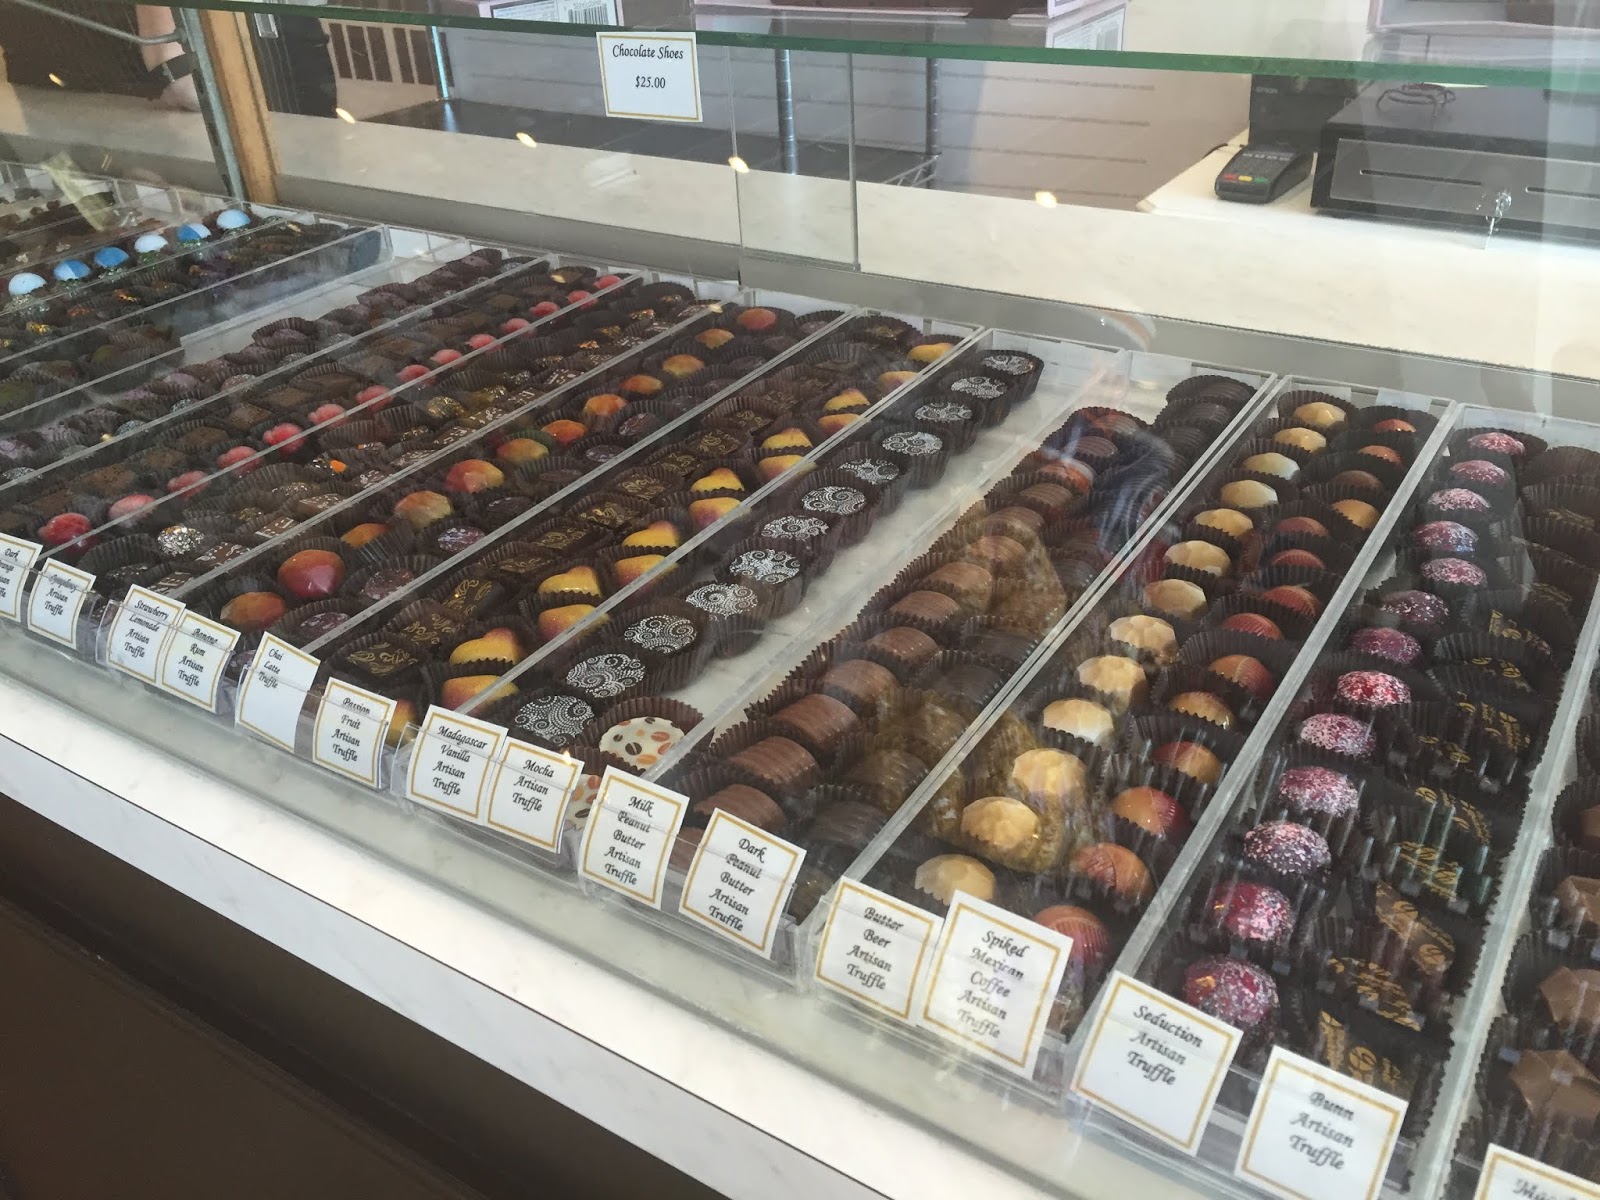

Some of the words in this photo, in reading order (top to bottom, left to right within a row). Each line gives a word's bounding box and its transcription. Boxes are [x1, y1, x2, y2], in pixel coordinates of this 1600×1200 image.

[612, 44, 656, 59] Chocolate
[657, 45, 684, 60] Shoes
[635, 76, 666, 89] $25.00
[4, 548, 20, 561] Dark
[46, 588, 68, 603] Artisan
[45, 601, 64, 615] Truffle
[135, 600, 169, 621] Strawberry
[129, 613, 160, 632] Lemonade
[125, 628, 150, 644] Artisan
[124, 642, 145, 658] Truffle
[190, 643, 206, 656] Rum
[268, 648, 284, 661] Chai
[179, 656, 204, 672] Artisan
[264, 661, 281, 674] Latte
[178, 669, 200, 687] Truffle
[258, 671, 278, 689] Truffle
[341, 714, 361, 730] Fruit
[331, 729, 360, 746] Artisan
[438, 725, 488, 749] Madagascar
[333, 745, 358, 762] Truffle
[440, 744, 470, 763] Vanilla
[433, 761, 465, 779] Artisan
[523, 759, 555, 778] Mocha
[432, 777, 461, 795] Truffle
[513, 775, 549, 795] Artisan
[512, 792, 543, 812] Truffle
[628, 796, 655, 818] Milk
[617, 811, 651, 833] Peanut
[613, 829, 646, 850] Butter
[604, 846, 641, 869] Artisan
[738, 838, 766, 864] Dark
[604, 863, 638, 885] Truffle
[725, 853, 763, 879] Peanut
[720, 871, 755, 896] Butter
[709, 888, 749, 916] Artisan
[708, 905, 744, 931] Truffle
[864, 907, 904, 931] Butter
[862, 928, 892, 948] Beer
[981, 930, 1030, 958] Spiked
[846, 945, 892, 972] Artisan
[969, 947, 1024, 980] Mexican
[846, 964, 887, 990] Truffle
[970, 970, 1011, 998] Coffee
[957, 990, 1007, 1021] Artisan
[957, 1008, 1001, 1039] Truffle
[1133, 1005, 1204, 1049] Seduction
[1129, 1031, 1187, 1066] Artisan
[1127, 1051, 1176, 1087] Truffle
[1290, 1111, 1355, 1149] Artisan
[1288, 1134, 1345, 1171] Truffle
